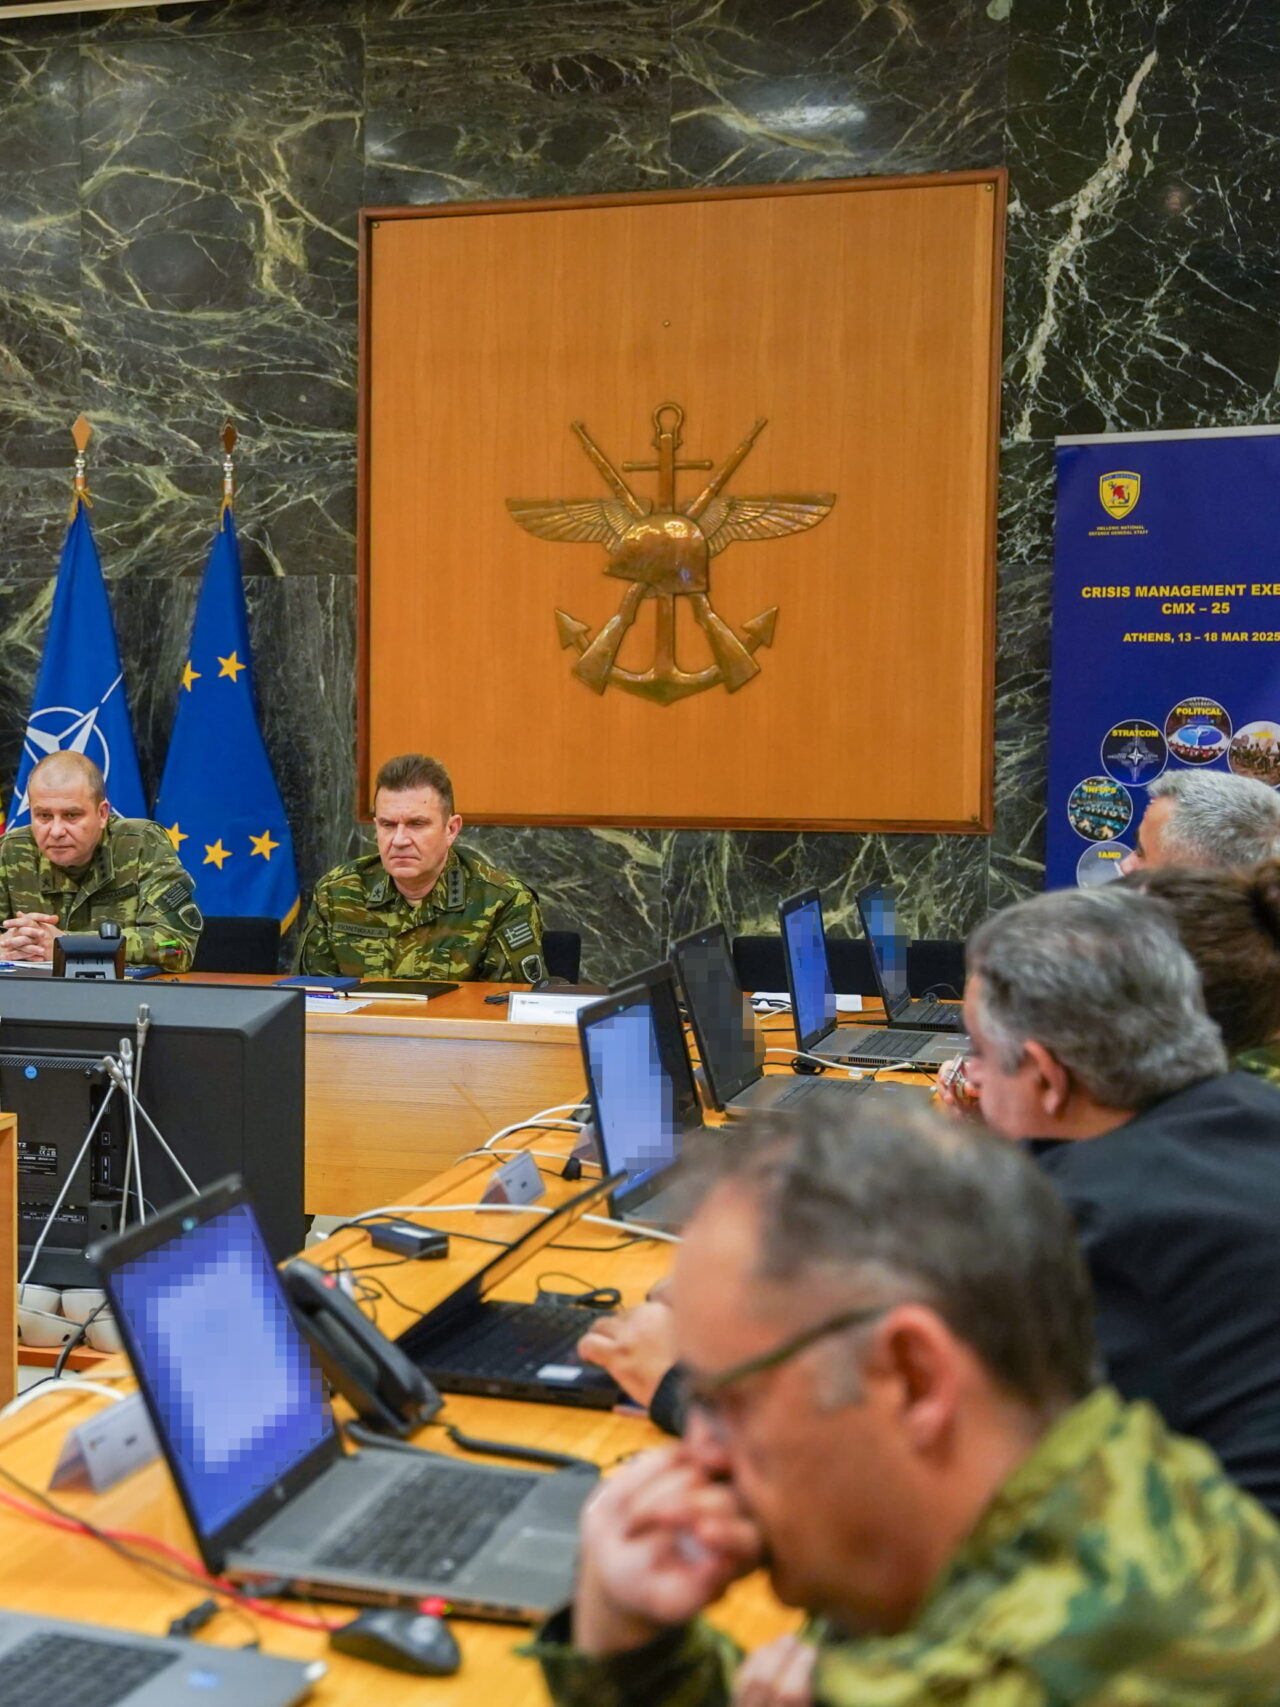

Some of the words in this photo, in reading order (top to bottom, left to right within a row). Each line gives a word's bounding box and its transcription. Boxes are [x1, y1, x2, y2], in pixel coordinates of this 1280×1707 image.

[1081, 586, 1131, 598] CRISIS
[1135, 584, 1247, 598] MANAGEMENT
[1161, 602, 1196, 614] CMX
[1211, 602, 1231, 614] 25
[1122, 632, 1175, 643] ATHENS,
[1178, 632, 1192, 642] 13
[1203, 632, 1218, 642] 18
[1221, 632, 1249, 642] MAR
[1252, 632, 1280, 642] 2025
[1176, 707, 1222, 716] POLITICAL
[1111, 729, 1159, 737] STRATCOM
